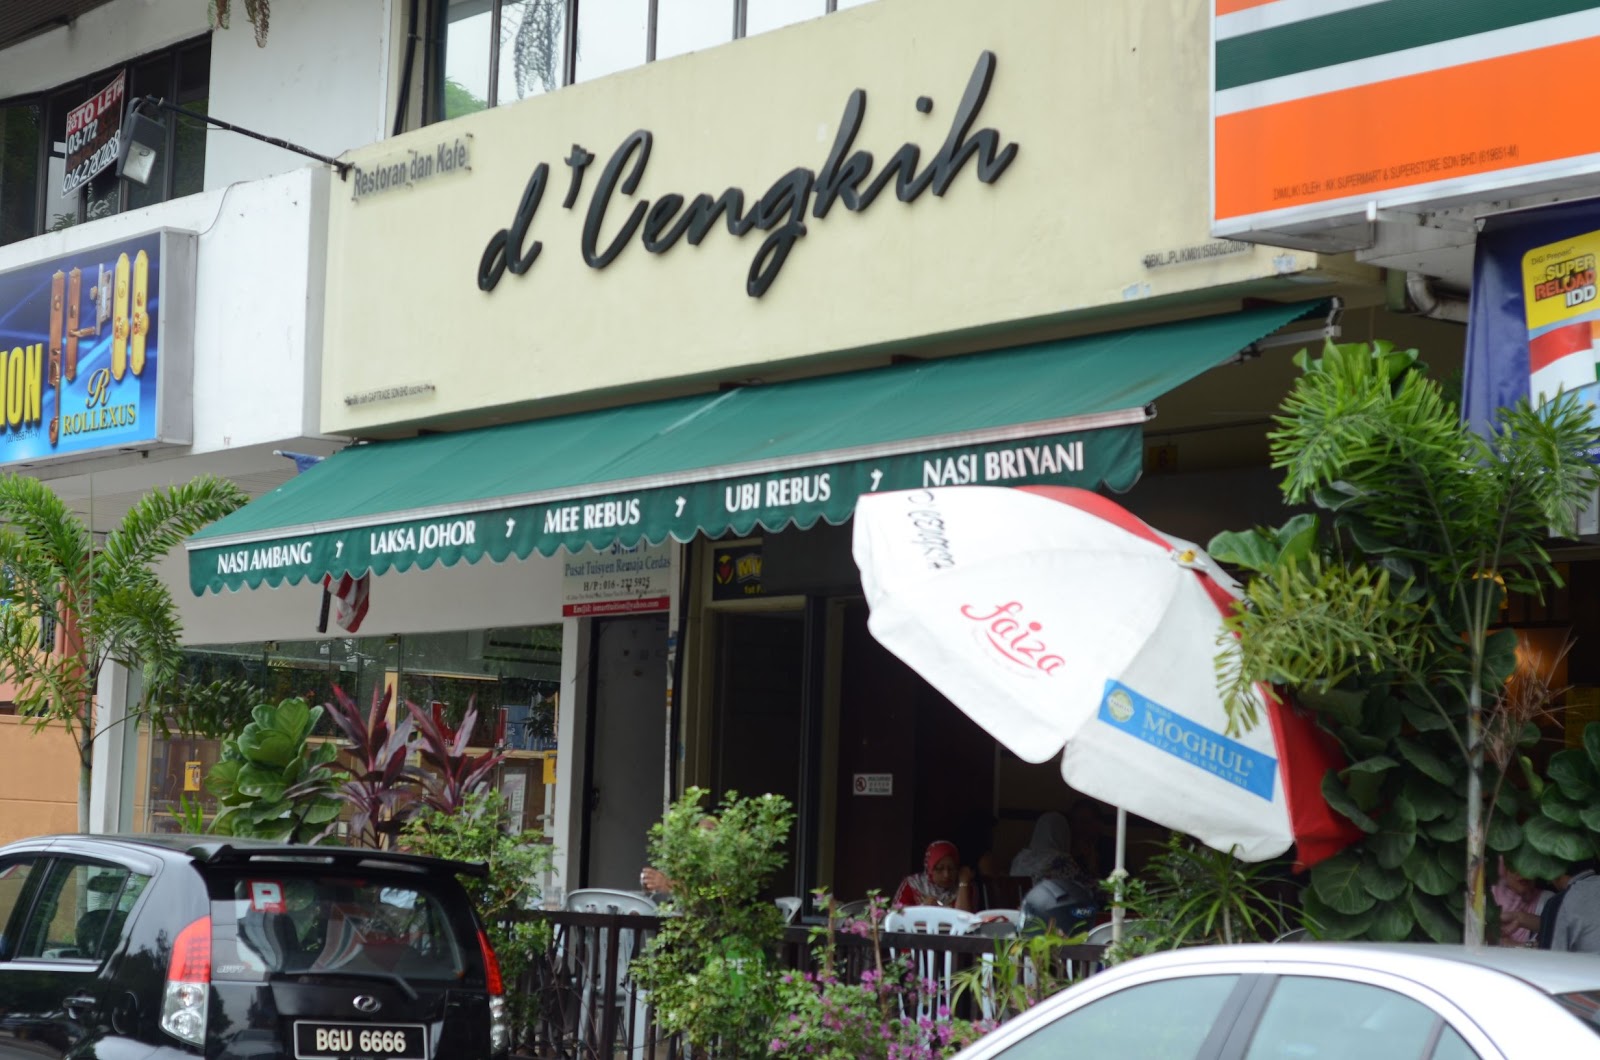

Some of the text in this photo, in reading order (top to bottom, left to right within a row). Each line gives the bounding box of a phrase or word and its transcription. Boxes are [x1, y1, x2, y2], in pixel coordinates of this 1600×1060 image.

[76, 102, 94, 128] TO
[97, 85, 118, 115] LET
[353, 138, 465, 197] Restoran dan Kafe
[1338, 168, 1382, 190] SUPERMART
[1383, 168, 1389, 180] &
[1390, 158, 1440, 178] SUPERSTORE
[1443, 153, 1460, 169] SDN
[1461, 151, 1477, 166] BHD
[1545, 254, 1596, 281] SUPER
[1535, 271, 1597, 302] RELOAD
[1566, 284, 1597, 309] IDD
[62, 404, 136, 436] ROLLEXUS
[923, 441, 1084, 487] NASI BRIYANI
[725, 473, 832, 513] UBI REBUS
[544, 498, 641, 535] MEE REBUS
[370, 520, 476, 556] LAKSA JOHOR
[217, 541, 312, 575] NASI AMBANG
[565, 555, 670, 577] Pusat Tuisyen Remaja Cerdas
[603, 579, 615, 590] 016
[960, 601, 1065, 676] faiza
[252, 882, 282, 909] P
[316, 1028, 407, 1053] BGU 6666
